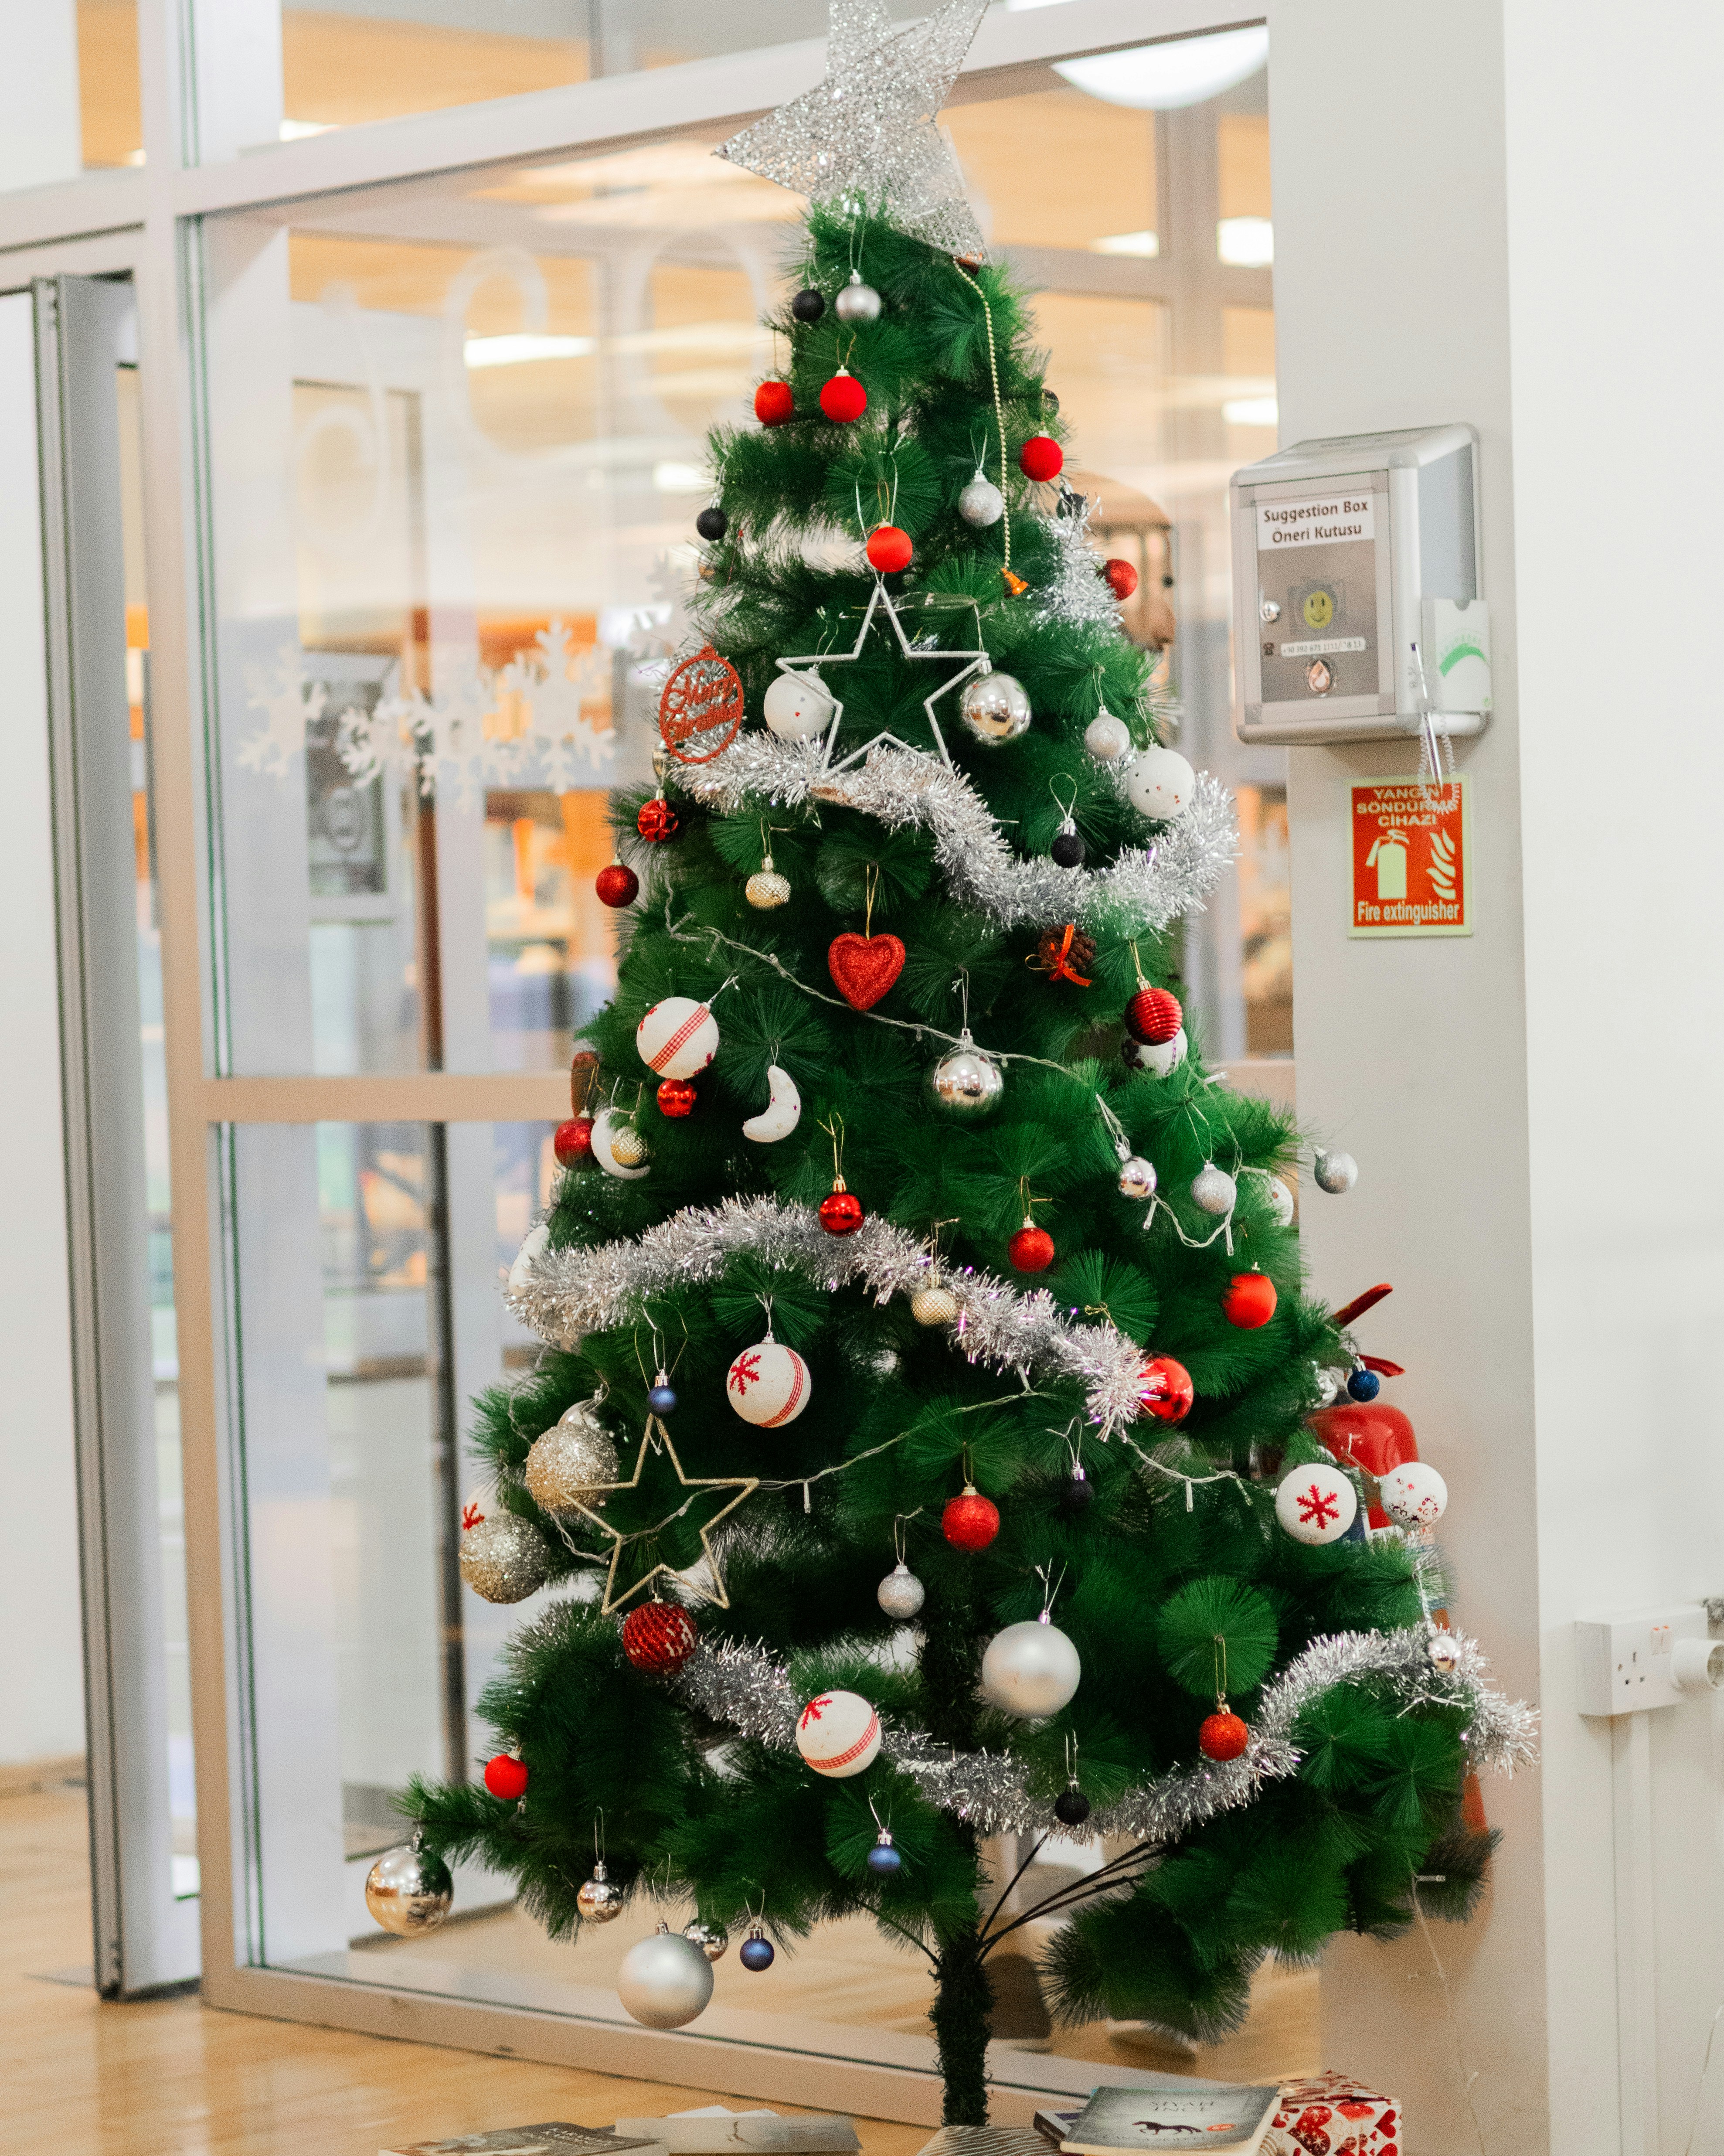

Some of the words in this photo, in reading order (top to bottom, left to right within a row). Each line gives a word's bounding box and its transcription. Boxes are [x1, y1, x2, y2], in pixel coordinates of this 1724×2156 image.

[1264, 504, 1338, 524] Suggestion
[1343, 501, 1368, 514] Box
[1272, 526, 1310, 543] Öneri
[1315, 524, 1361, 539] Kutusu
[1358, 900, 1381, 921] Fire
[1383, 899, 1459, 925] extinguisher
